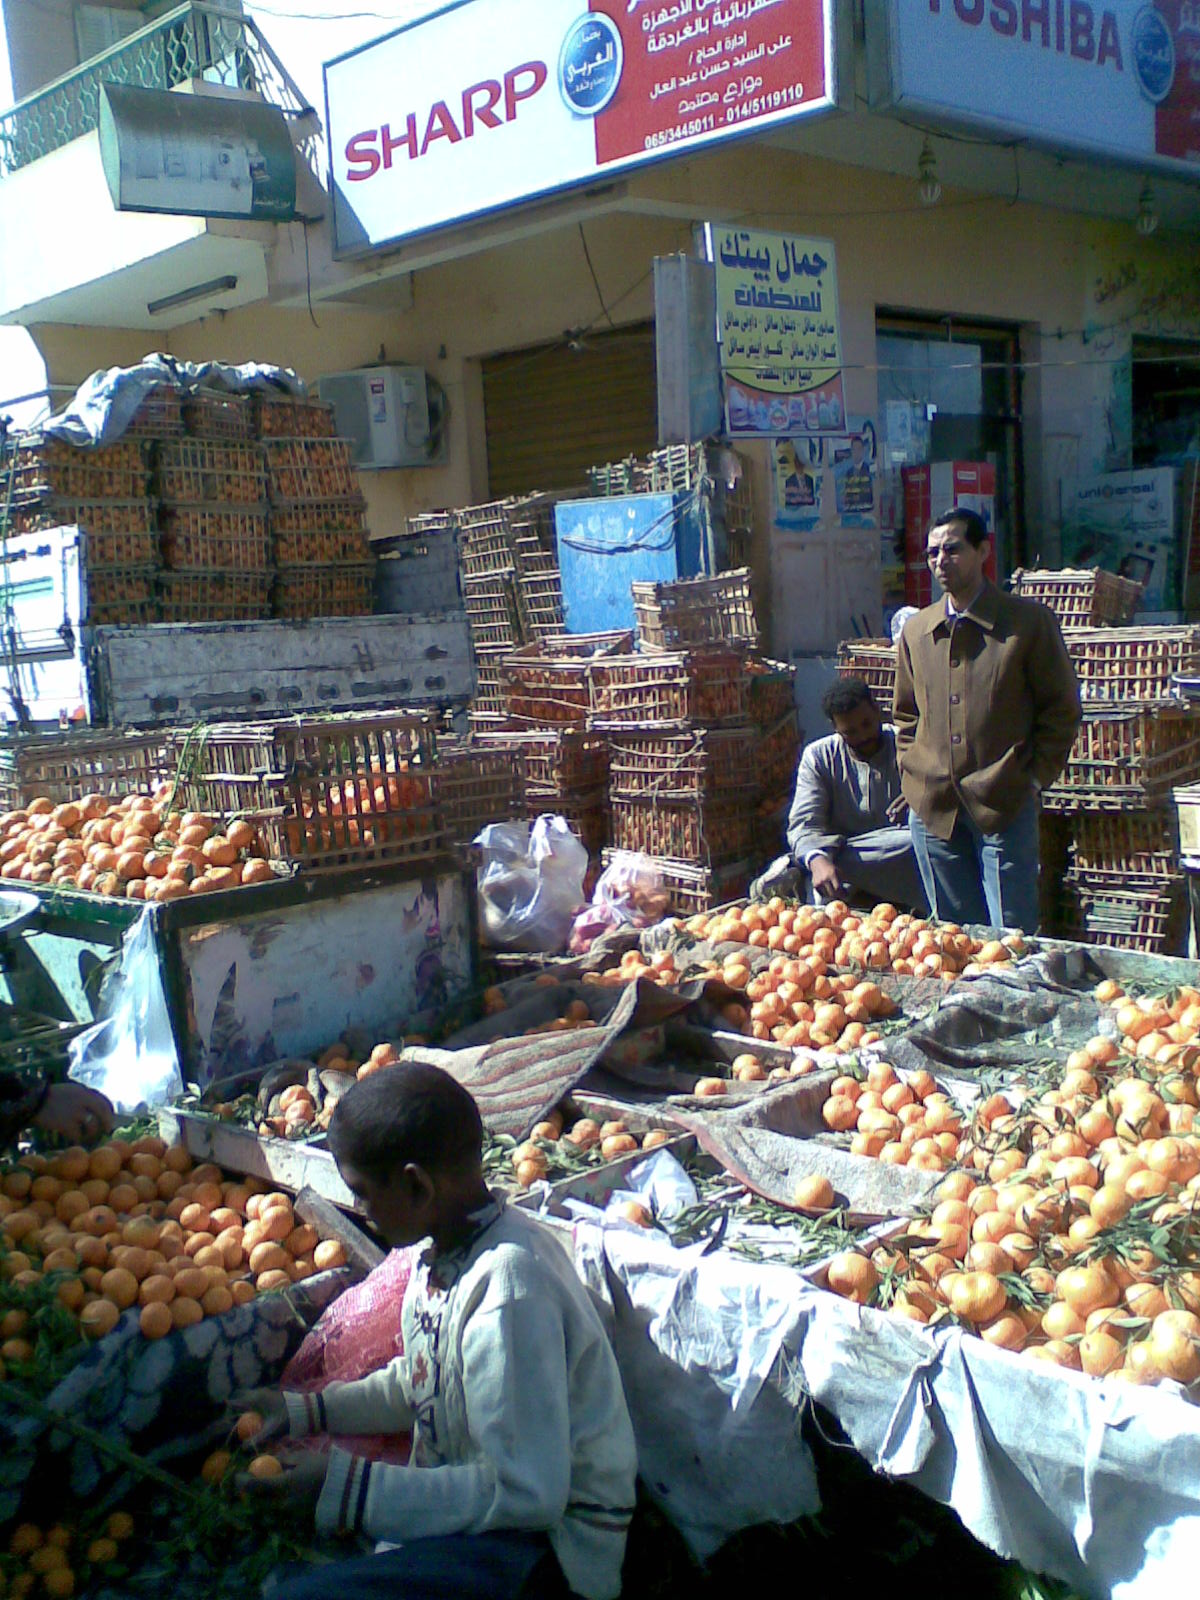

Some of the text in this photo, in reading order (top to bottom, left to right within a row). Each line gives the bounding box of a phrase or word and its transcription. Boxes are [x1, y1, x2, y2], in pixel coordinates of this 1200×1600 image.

[647, 17, 710, 52] بالغردقة
[929, 0, 1123, 71] SHIBA
[696, 41, 722, 64] الحاج
[733, 43, 765, 66] السيد
[678, 72, 698, 87] عبد
[700, 60, 730, 80] حسن
[650, 77, 676, 99] العال
[678, 76, 763, 114] موزع معتمد
[345, 60, 548, 181] SHARP
[720, 232, 827, 287] جمال بيتك
[734, 283, 822, 312] للمنظفات
